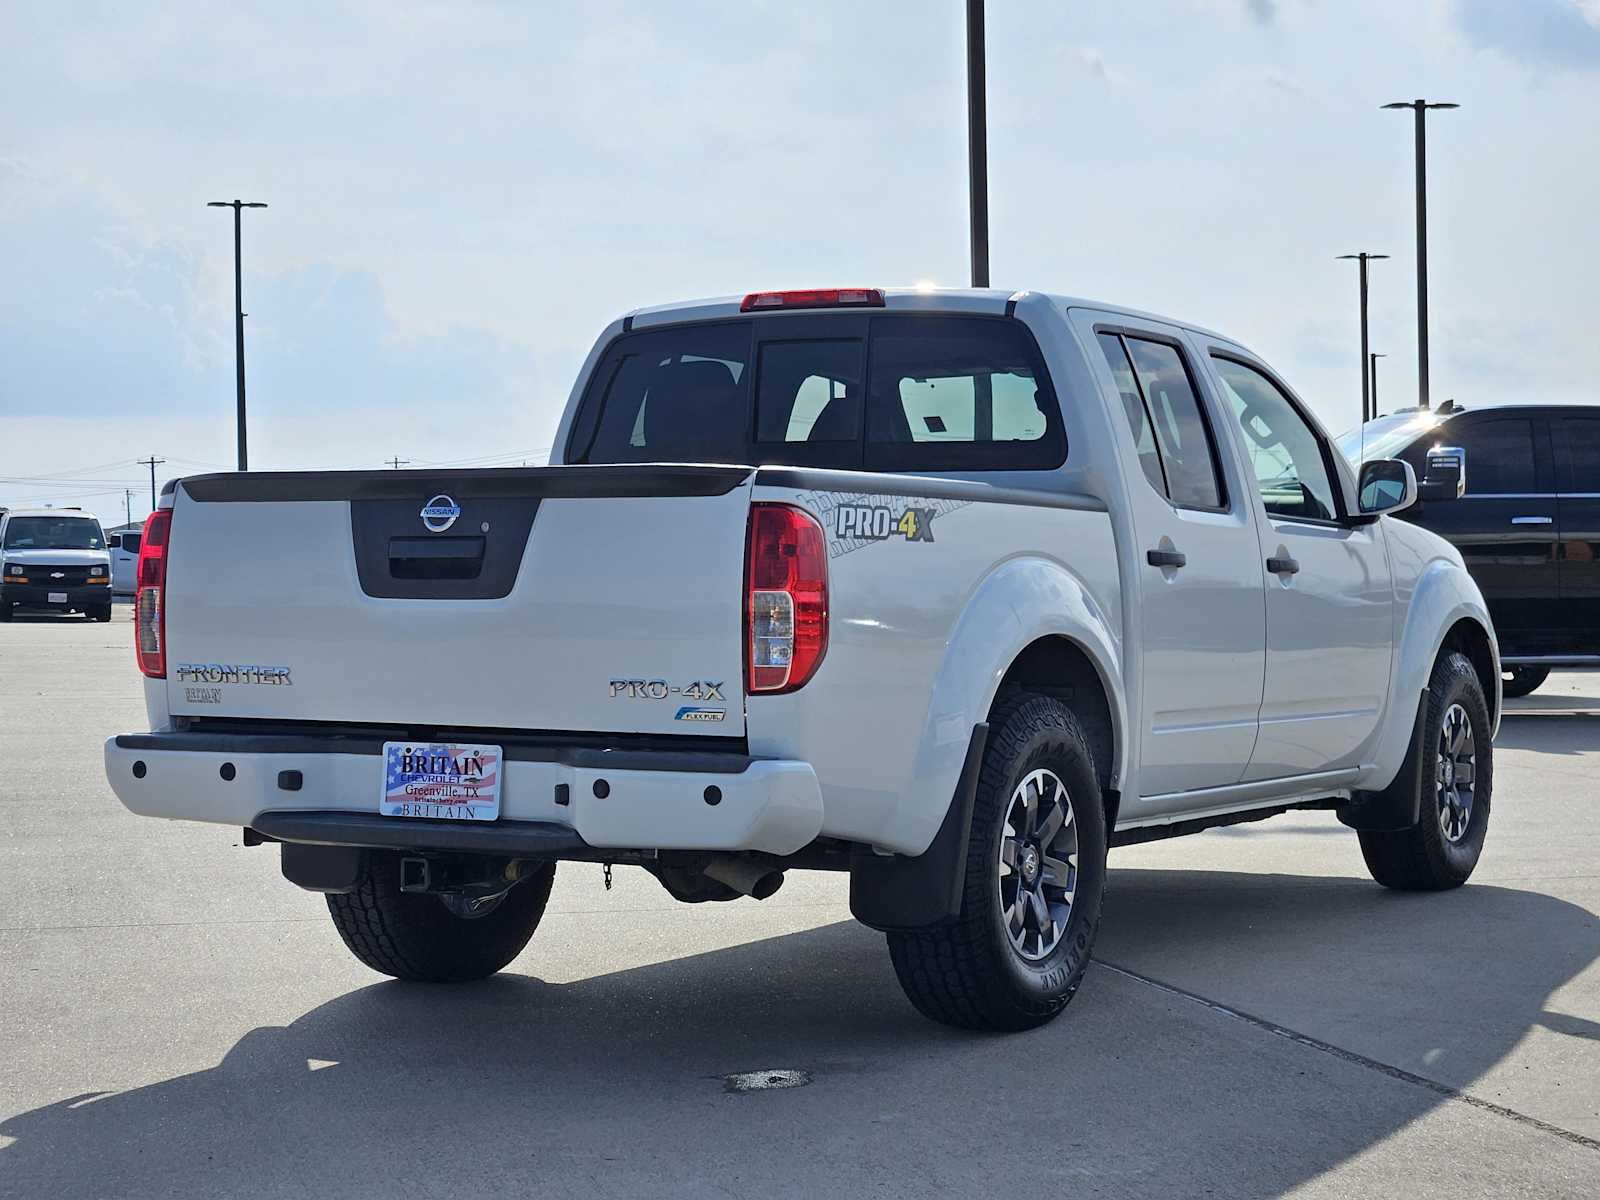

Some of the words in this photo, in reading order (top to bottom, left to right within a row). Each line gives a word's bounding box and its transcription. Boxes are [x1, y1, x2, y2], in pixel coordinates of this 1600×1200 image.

[423, 507, 456, 516] NISSAN
[836, 503, 937, 543] PRO-4X
[176, 664, 292, 686] FRONTIER
[608, 679, 727, 701] PRO-4X
[401, 755, 485, 776] BRITAIN
[400, 774, 462, 784] CHEVROLET
[405, 784, 461, 798] Greenville,
[463, 786, 479, 798] TX
[401, 804, 475, 818] BRITAIN
